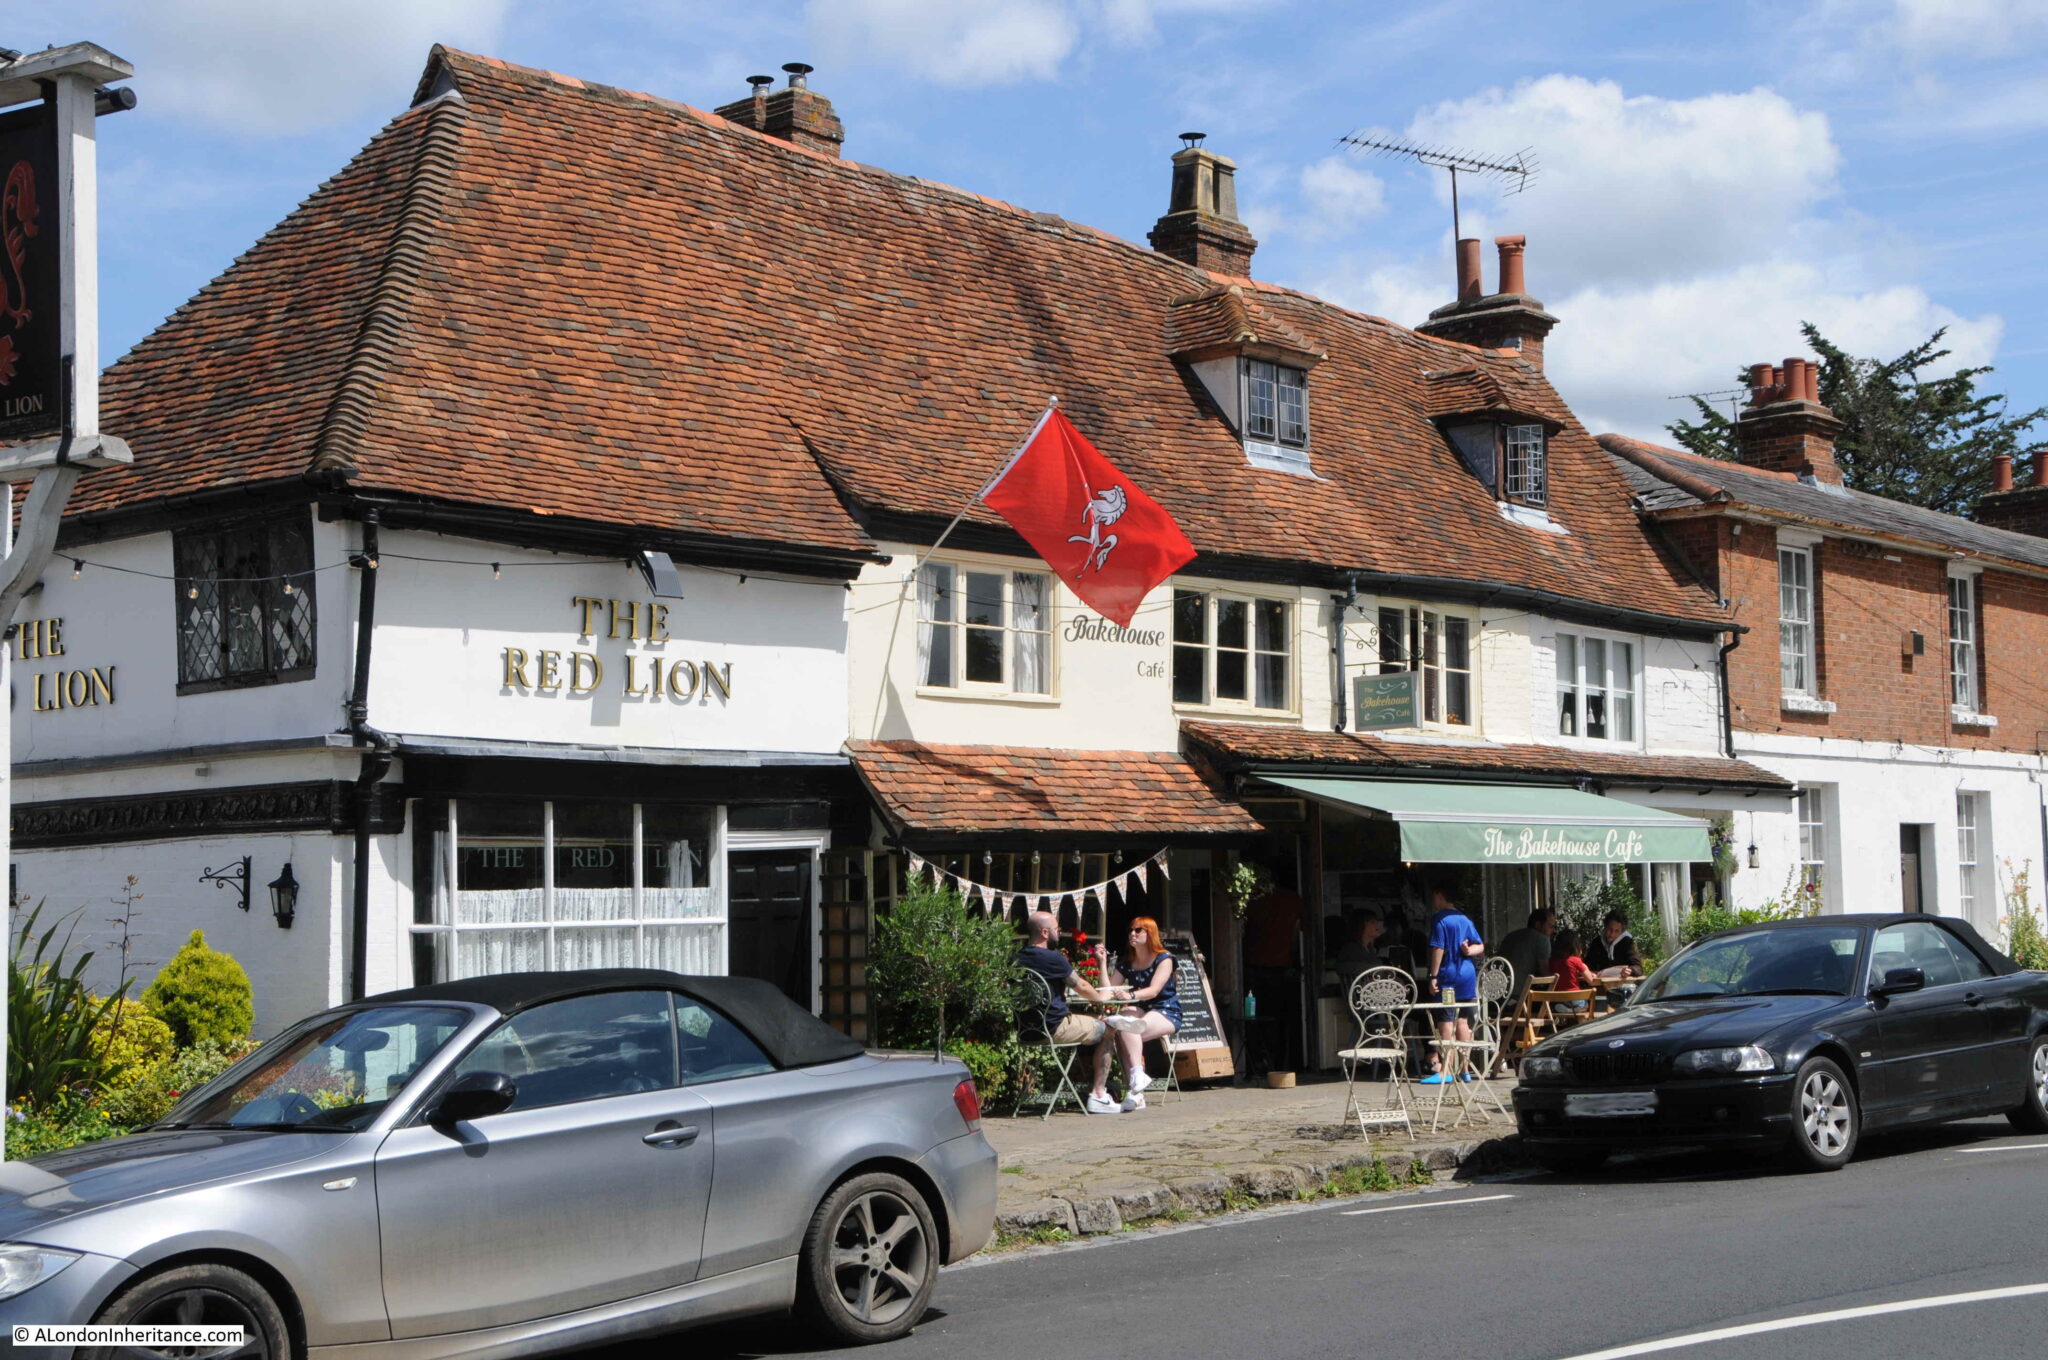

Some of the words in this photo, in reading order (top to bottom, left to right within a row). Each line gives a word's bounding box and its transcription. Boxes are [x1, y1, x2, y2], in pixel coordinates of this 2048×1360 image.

[5, 393, 43, 417] LION
[572, 596, 671, 643] THE
[1064, 614, 1165, 647] Bakehouse
[10, 617, 65, 661] HE
[503, 646, 604, 691] RED
[624, 654, 735, 699] LION
[1137, 660, 1165, 678] Café
[33, 665, 116, 712] LION
[1361, 694, 1411, 709] Bakehouse
[477, 847, 525, 868] THE
[571, 847, 615, 868] RED
[1484, 827, 1513, 857] The
[1516, 827, 1600, 859] Bakehouse
[1604, 828, 1643, 862] Café
